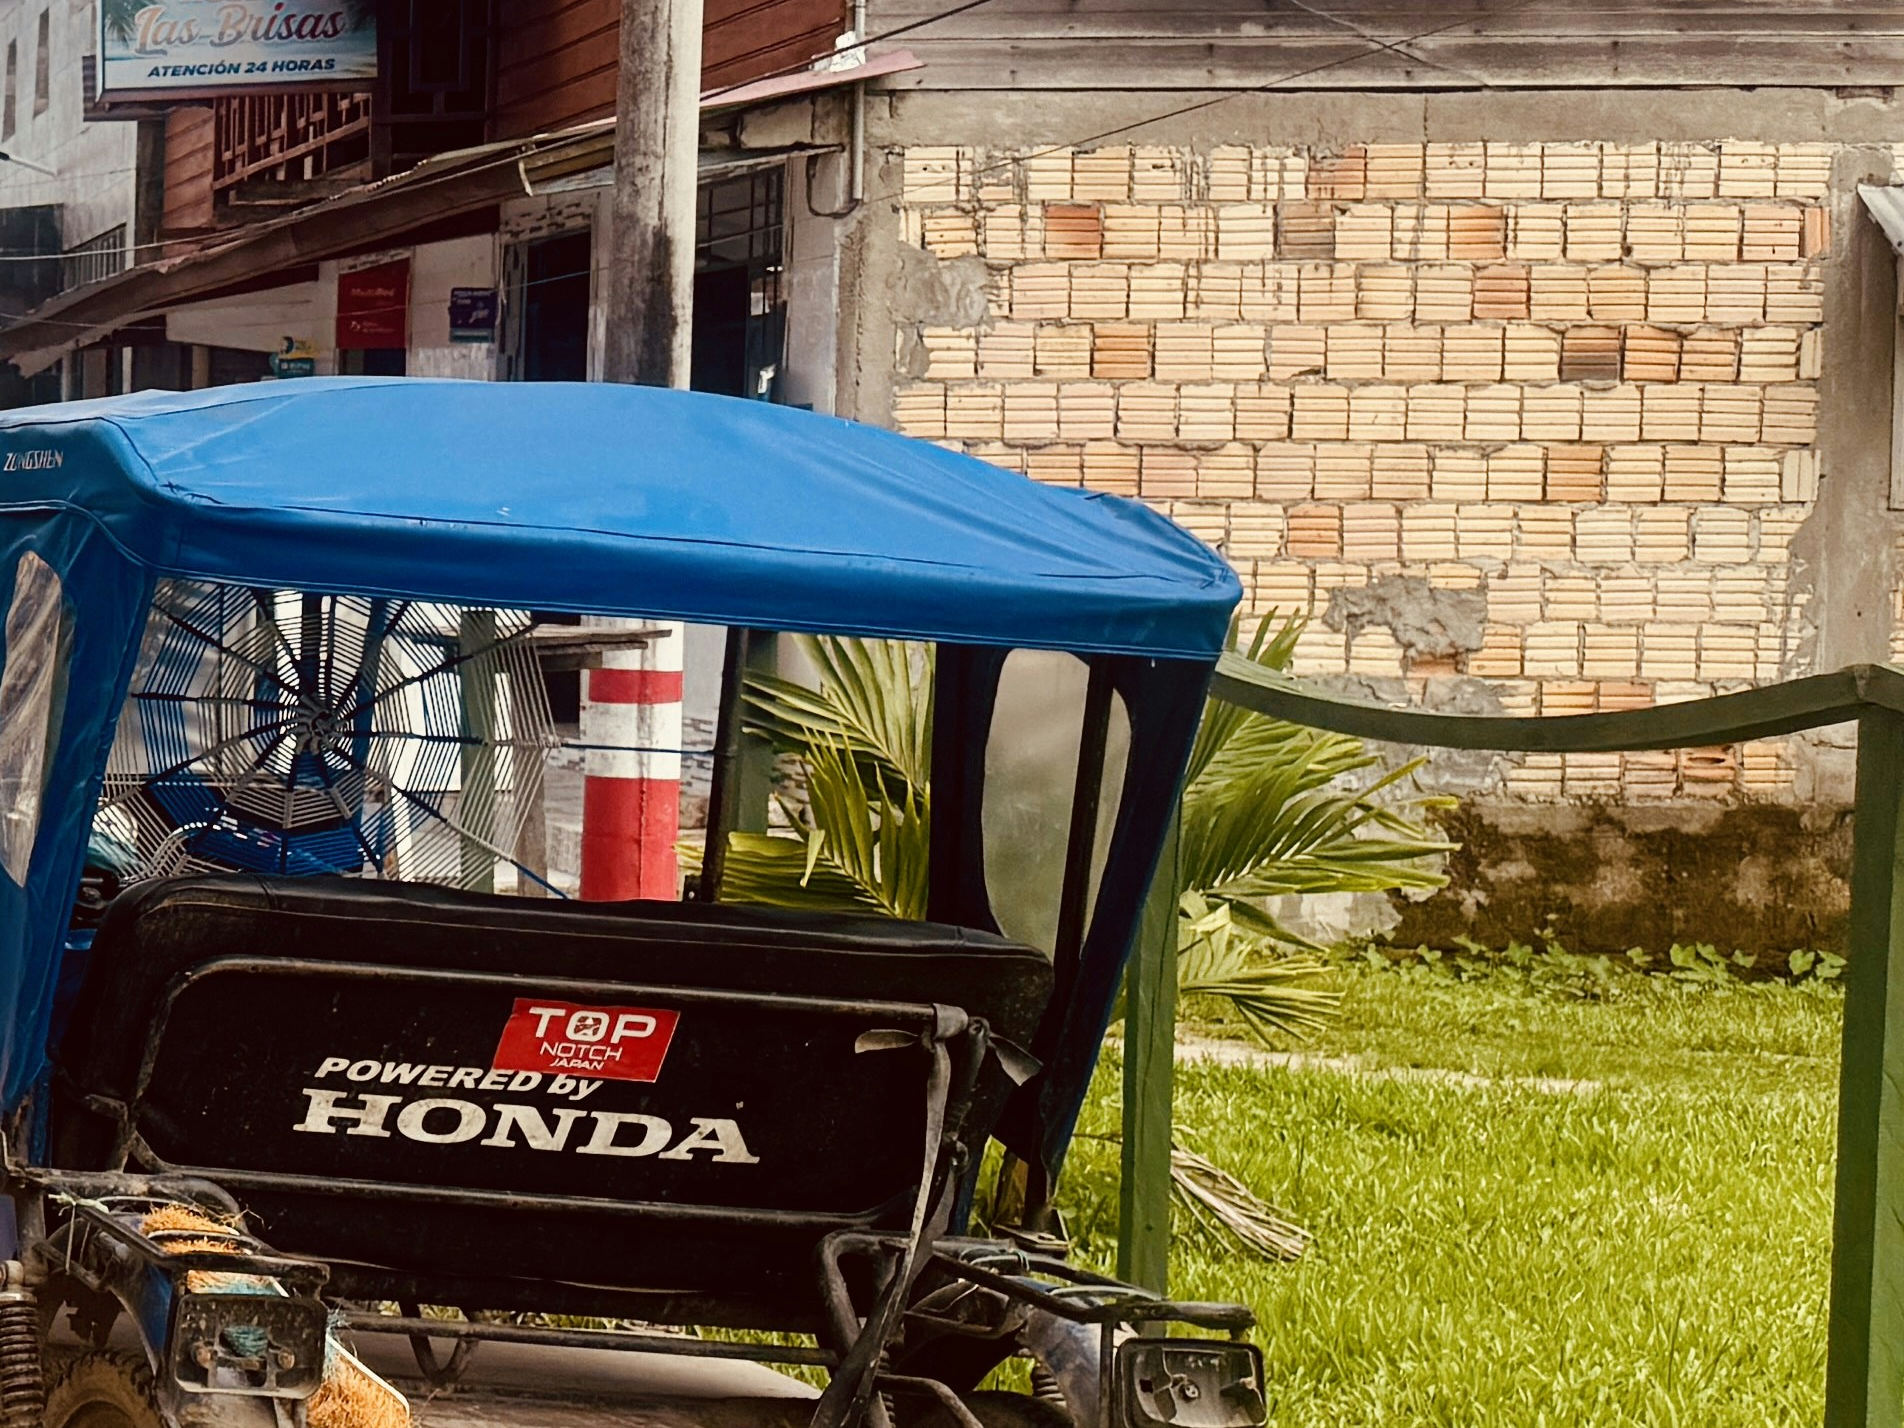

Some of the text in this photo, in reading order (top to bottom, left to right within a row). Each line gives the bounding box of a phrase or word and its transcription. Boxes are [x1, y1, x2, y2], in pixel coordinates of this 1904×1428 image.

[135, 2, 346, 56] Las Brisas
[148, 58, 336, 78] ATENCIÓN 24 HORAS
[528, 1006, 657, 1044] TOP
[540, 1041, 623, 1061] NOTCH
[549, 1057, 605, 1071] JAPAN
[314, 1057, 605, 1101] POWERED by
[292, 1088, 761, 1164] HONDA
